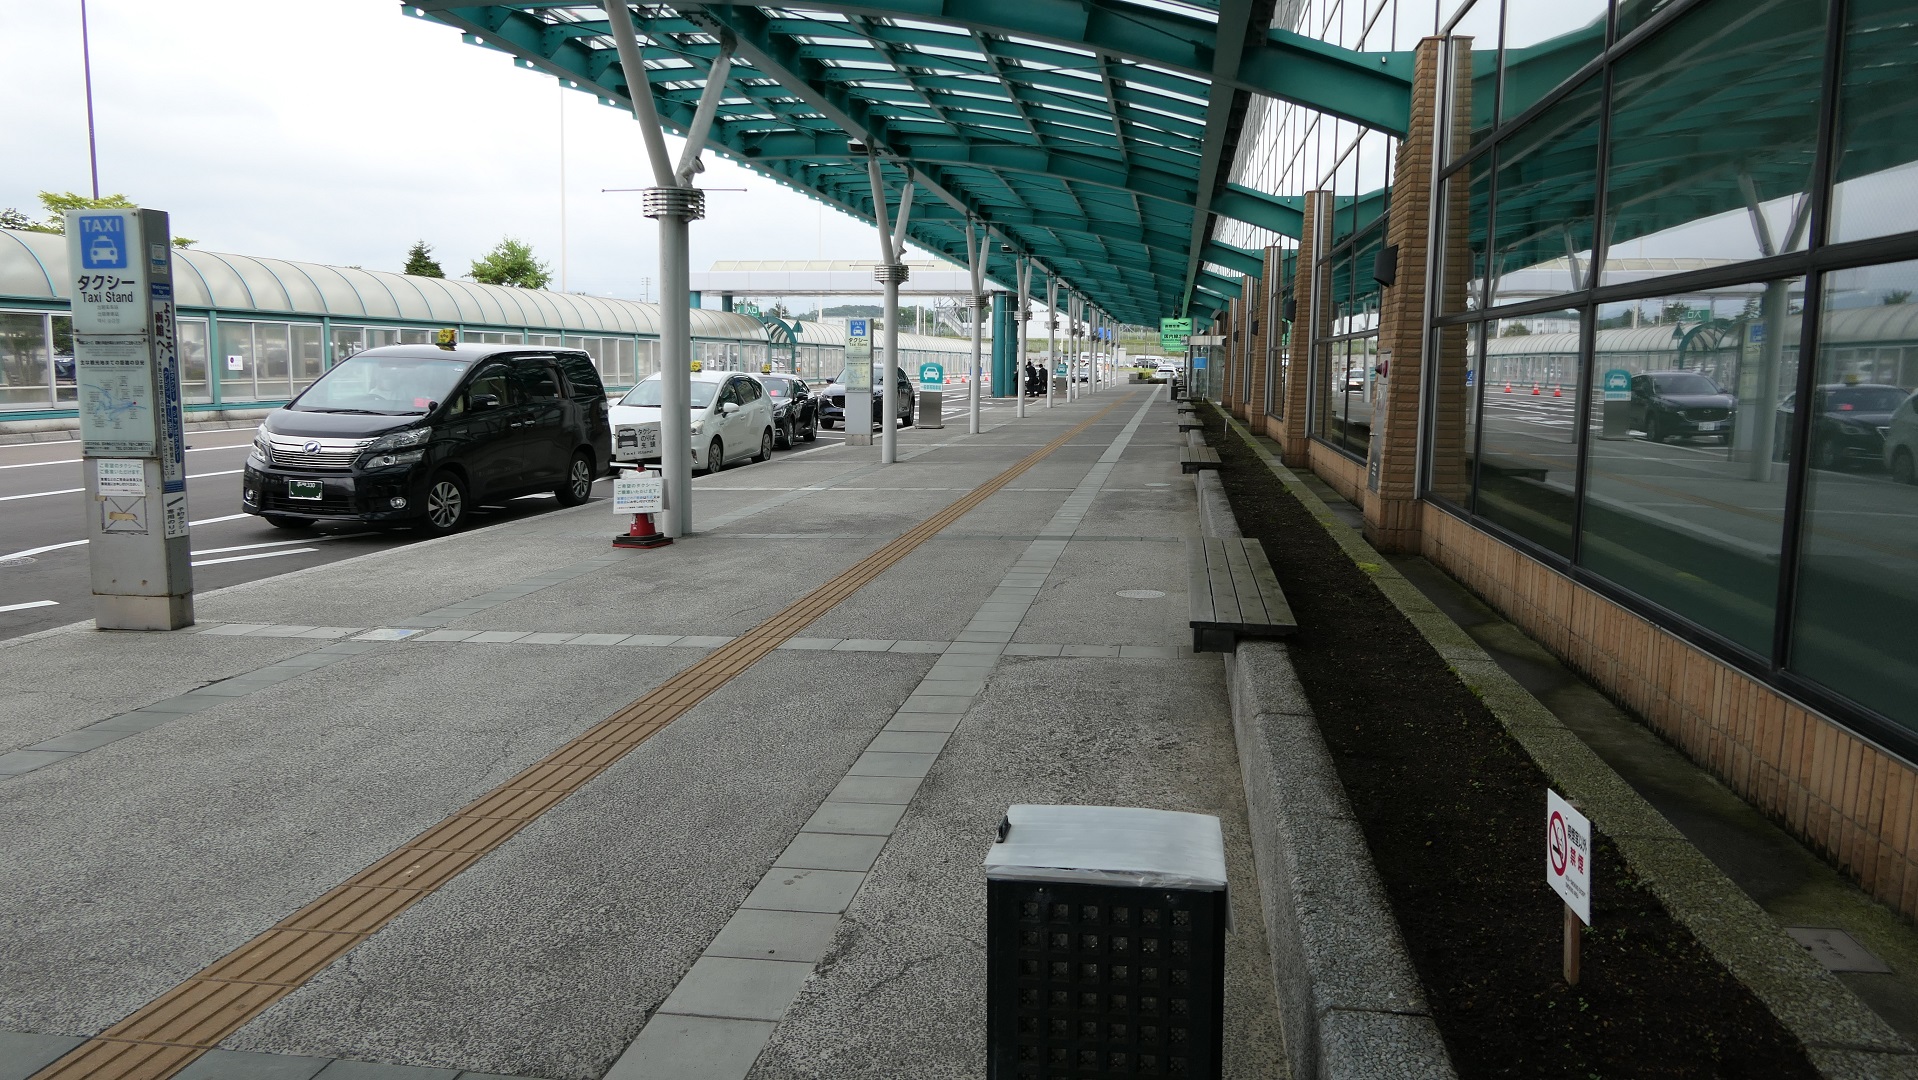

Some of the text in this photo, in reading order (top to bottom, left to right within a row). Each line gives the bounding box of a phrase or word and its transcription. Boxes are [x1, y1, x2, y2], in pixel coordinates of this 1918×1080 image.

[82, 219, 120, 232] TAXI
[77, 275, 135, 291] タクシー
[81, 291, 134, 303] Taxi Stand
[163, 302, 174, 354] ようこそ
[641, 434, 656, 442] のりば
[1570, 846, 1584, 875] 禁煙
